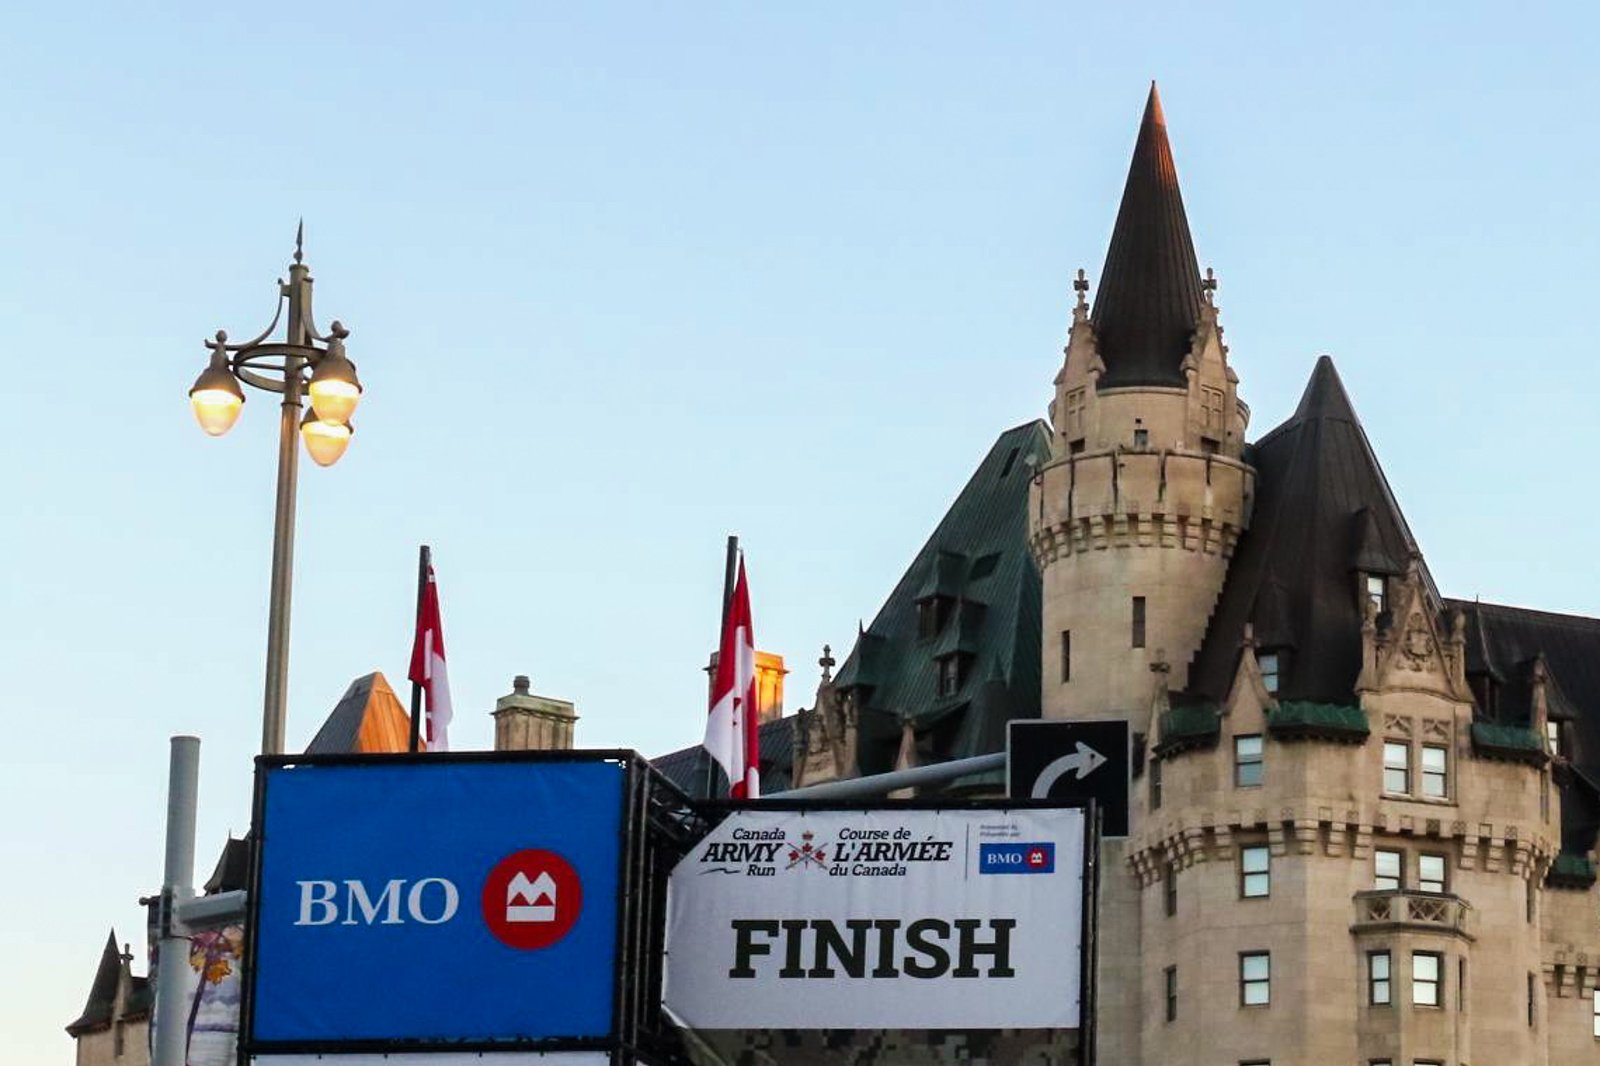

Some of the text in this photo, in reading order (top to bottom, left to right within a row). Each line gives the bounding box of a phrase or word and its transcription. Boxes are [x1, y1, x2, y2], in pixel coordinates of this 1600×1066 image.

[732, 828, 785, 841] Canada
[839, 828, 911, 840] Course de
[700, 842, 784, 862] ARMY
[832, 836, 953, 862] L'ARMÉE
[987, 853, 1022, 864] BMO
[747, 864, 775, 876] Run
[829, 864, 906, 876] du Canada
[293, 877, 459, 926] BMO
[729, 918, 1016, 979] FINISH
